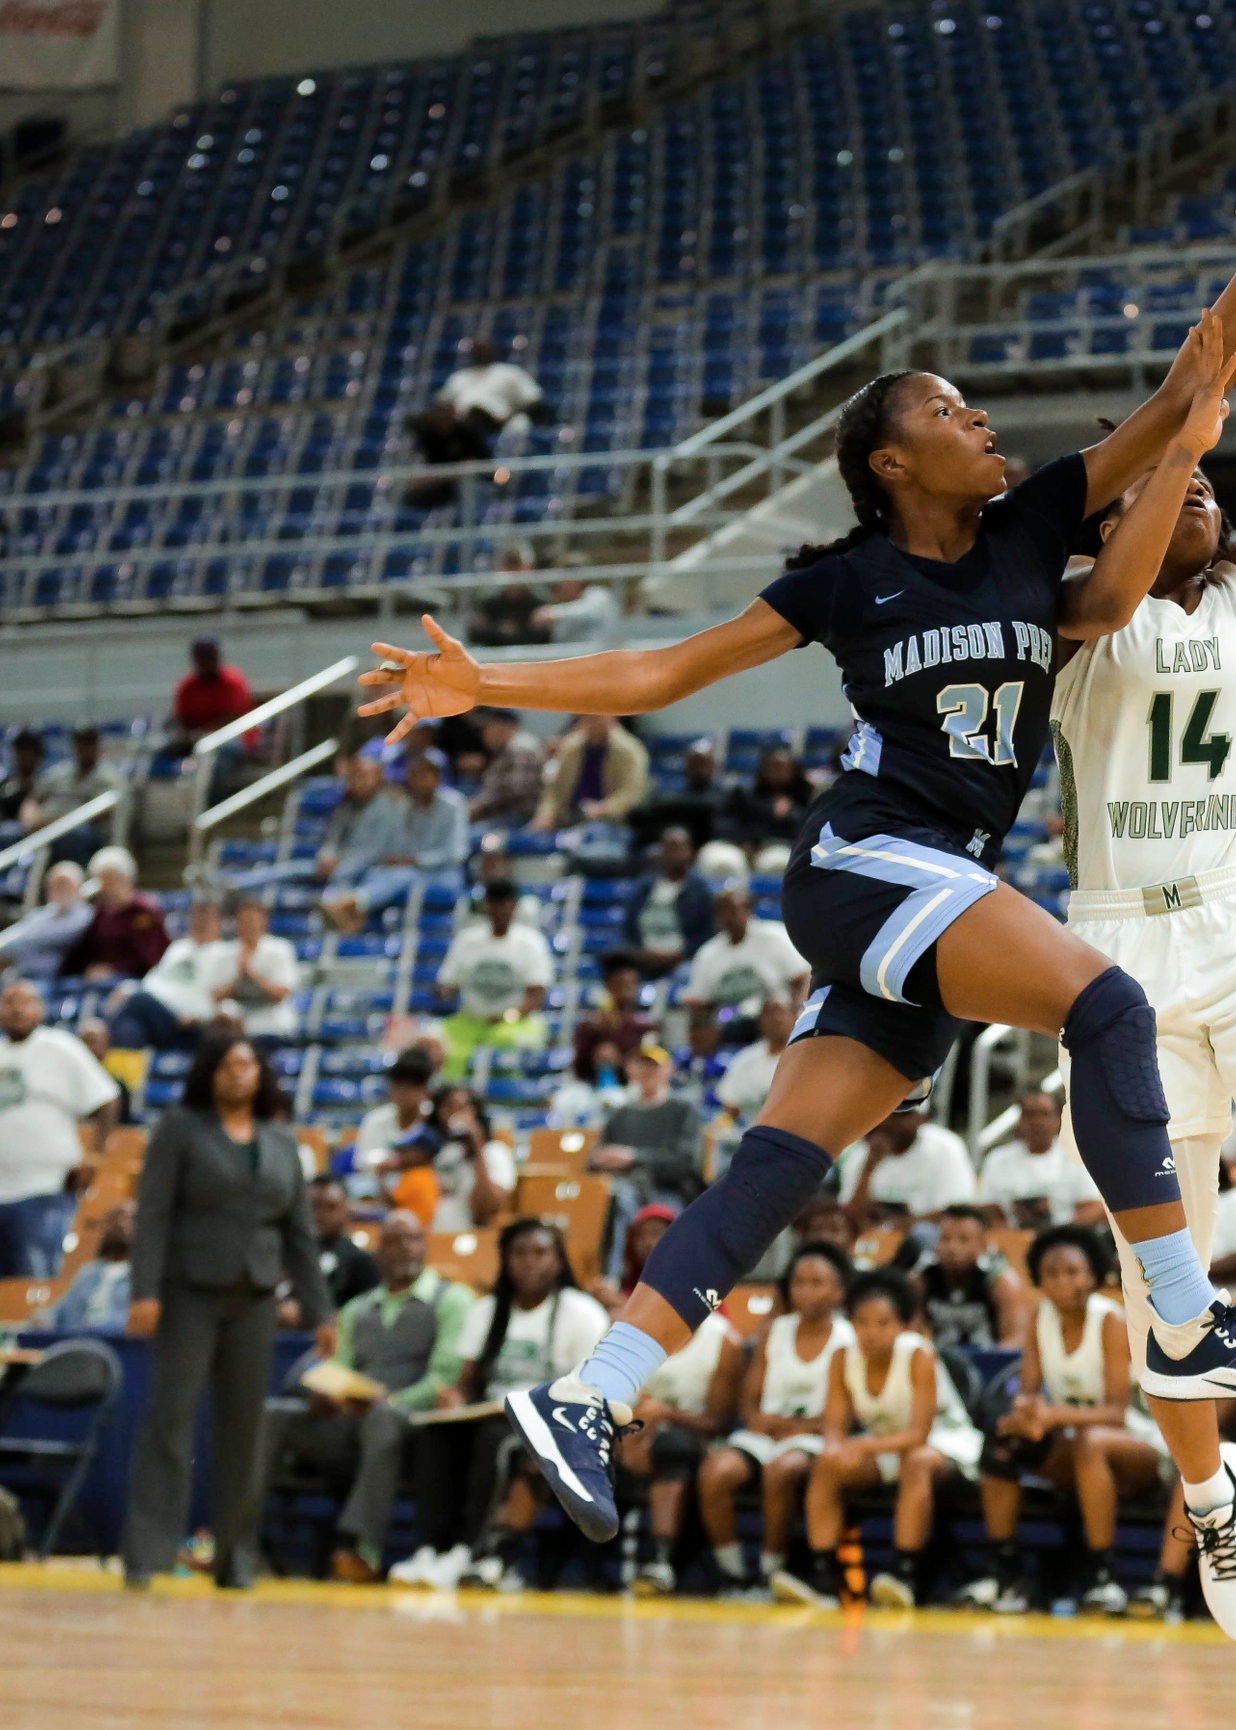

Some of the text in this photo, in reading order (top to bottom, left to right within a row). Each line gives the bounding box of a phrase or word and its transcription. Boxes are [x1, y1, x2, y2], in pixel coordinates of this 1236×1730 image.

[883, 620, 1053, 688] MADISON PRE
[1155, 636, 1222, 673] LADY
[936, 680, 1026, 769] 21
[1145, 687, 1233, 785] 14
[1162, 882, 1182, 909] M
